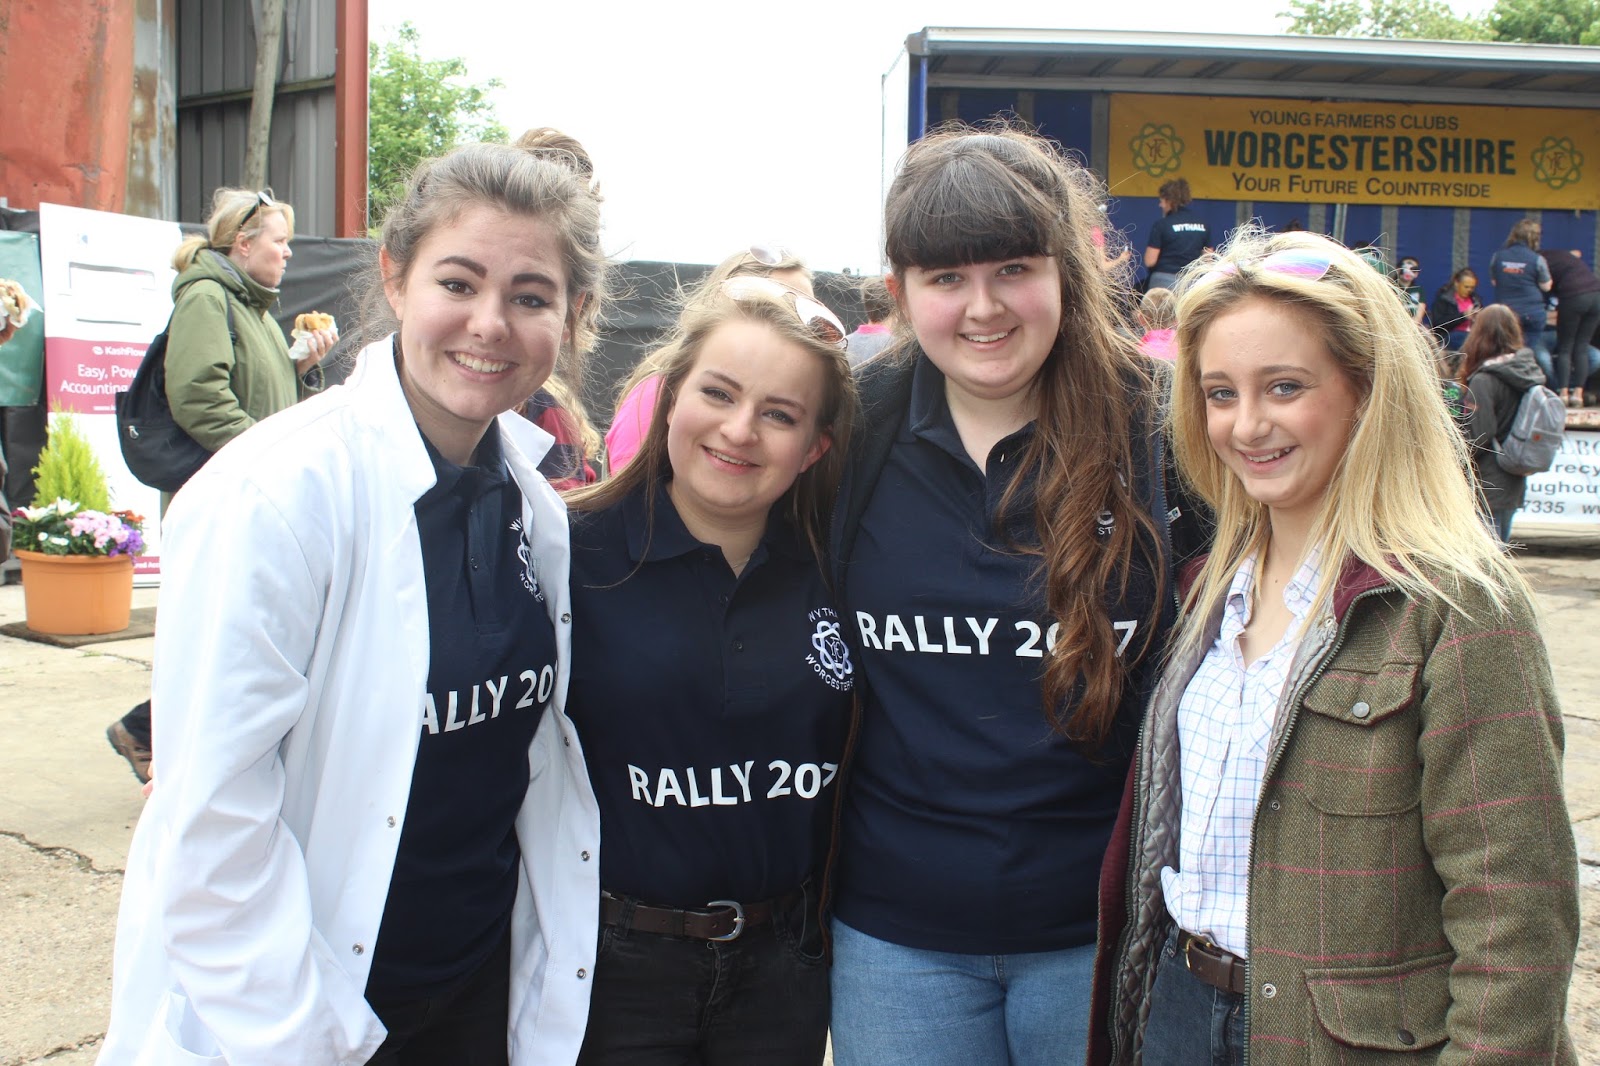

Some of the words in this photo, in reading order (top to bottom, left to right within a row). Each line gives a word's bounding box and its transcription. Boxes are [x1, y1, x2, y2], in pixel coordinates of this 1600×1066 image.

[1249, 109, 1311, 127] YOUNG
[1315, 112, 1396, 129] FARMERS
[1400, 114, 1459, 131] CLUBS
[1204, 129, 1517, 175] WORCESTERSHIRE
[1172, 223, 1206, 232] WYTHALL
[77, 363, 109, 381] Easy,
[855, 610, 999, 656] RALLY
[1014, 620, 1138, 658] 27
[515, 660, 558, 710] 20
[627, 759, 755, 808] RALLY
